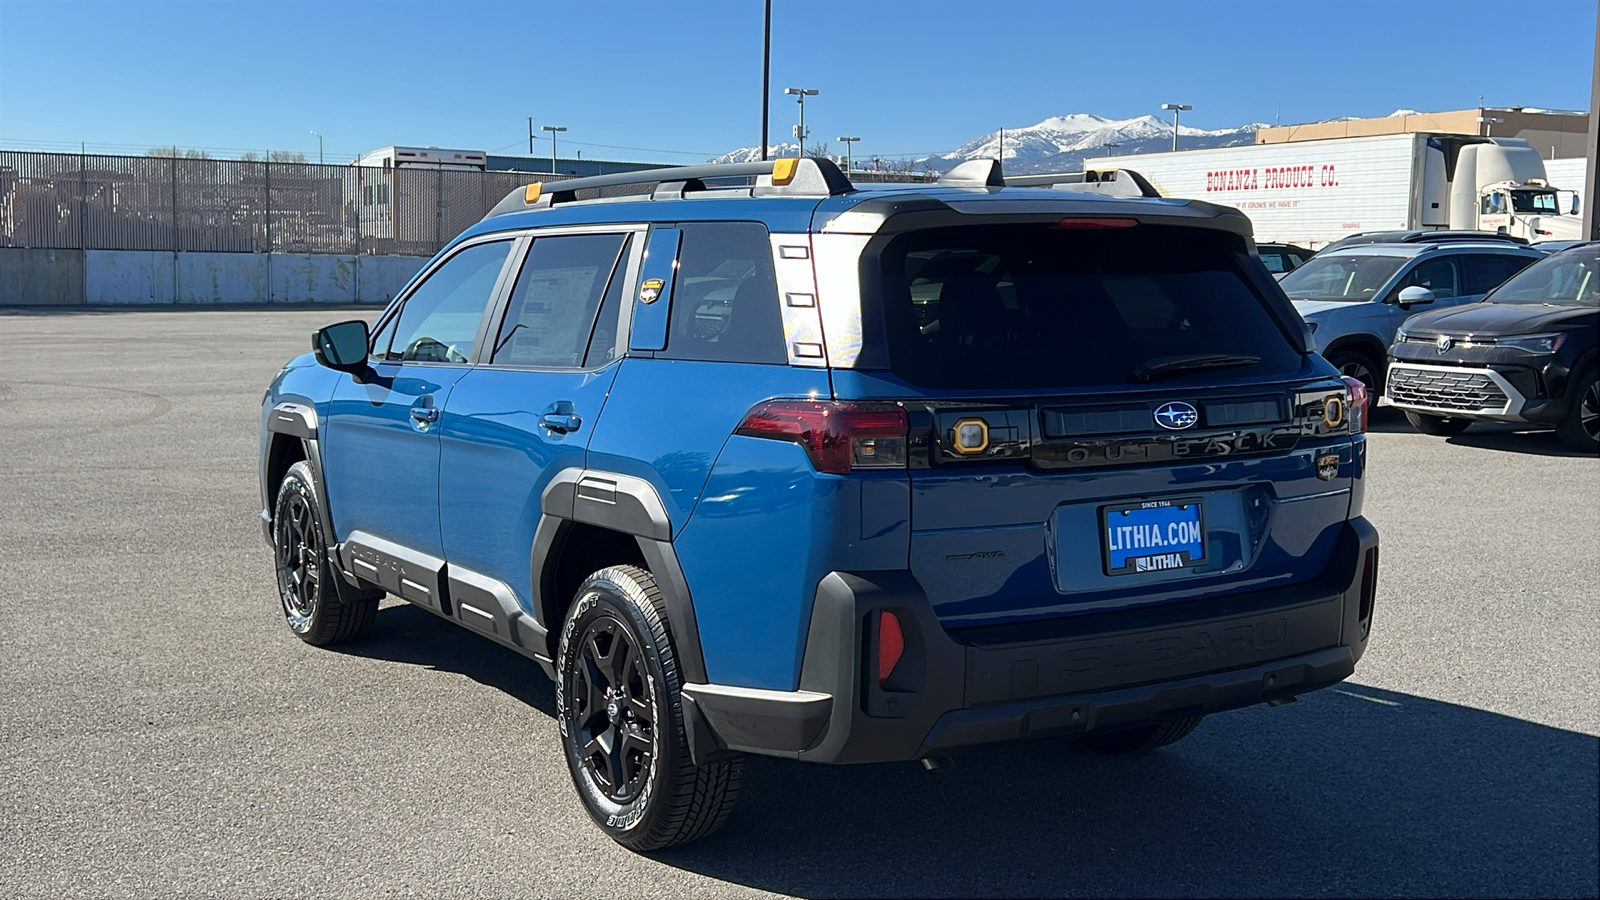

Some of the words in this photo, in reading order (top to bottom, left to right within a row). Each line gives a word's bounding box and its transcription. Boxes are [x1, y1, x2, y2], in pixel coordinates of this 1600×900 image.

[1206, 169, 1258, 192] BONANZA
[1264, 165, 1314, 189] PRODUCE
[1320, 164, 1339, 188] CO.
[1248, 201, 1267, 209] GROWS
[1066, 433, 1277, 463] OUTBACK
[1141, 501, 1158, 509] SINCE
[1108, 520, 1202, 551] LITHIA.COM
[351, 545, 407, 575] OUTBACK
[1147, 553, 1183, 571] LITHIA
[1062, 618, 1288, 679] SUBARU
